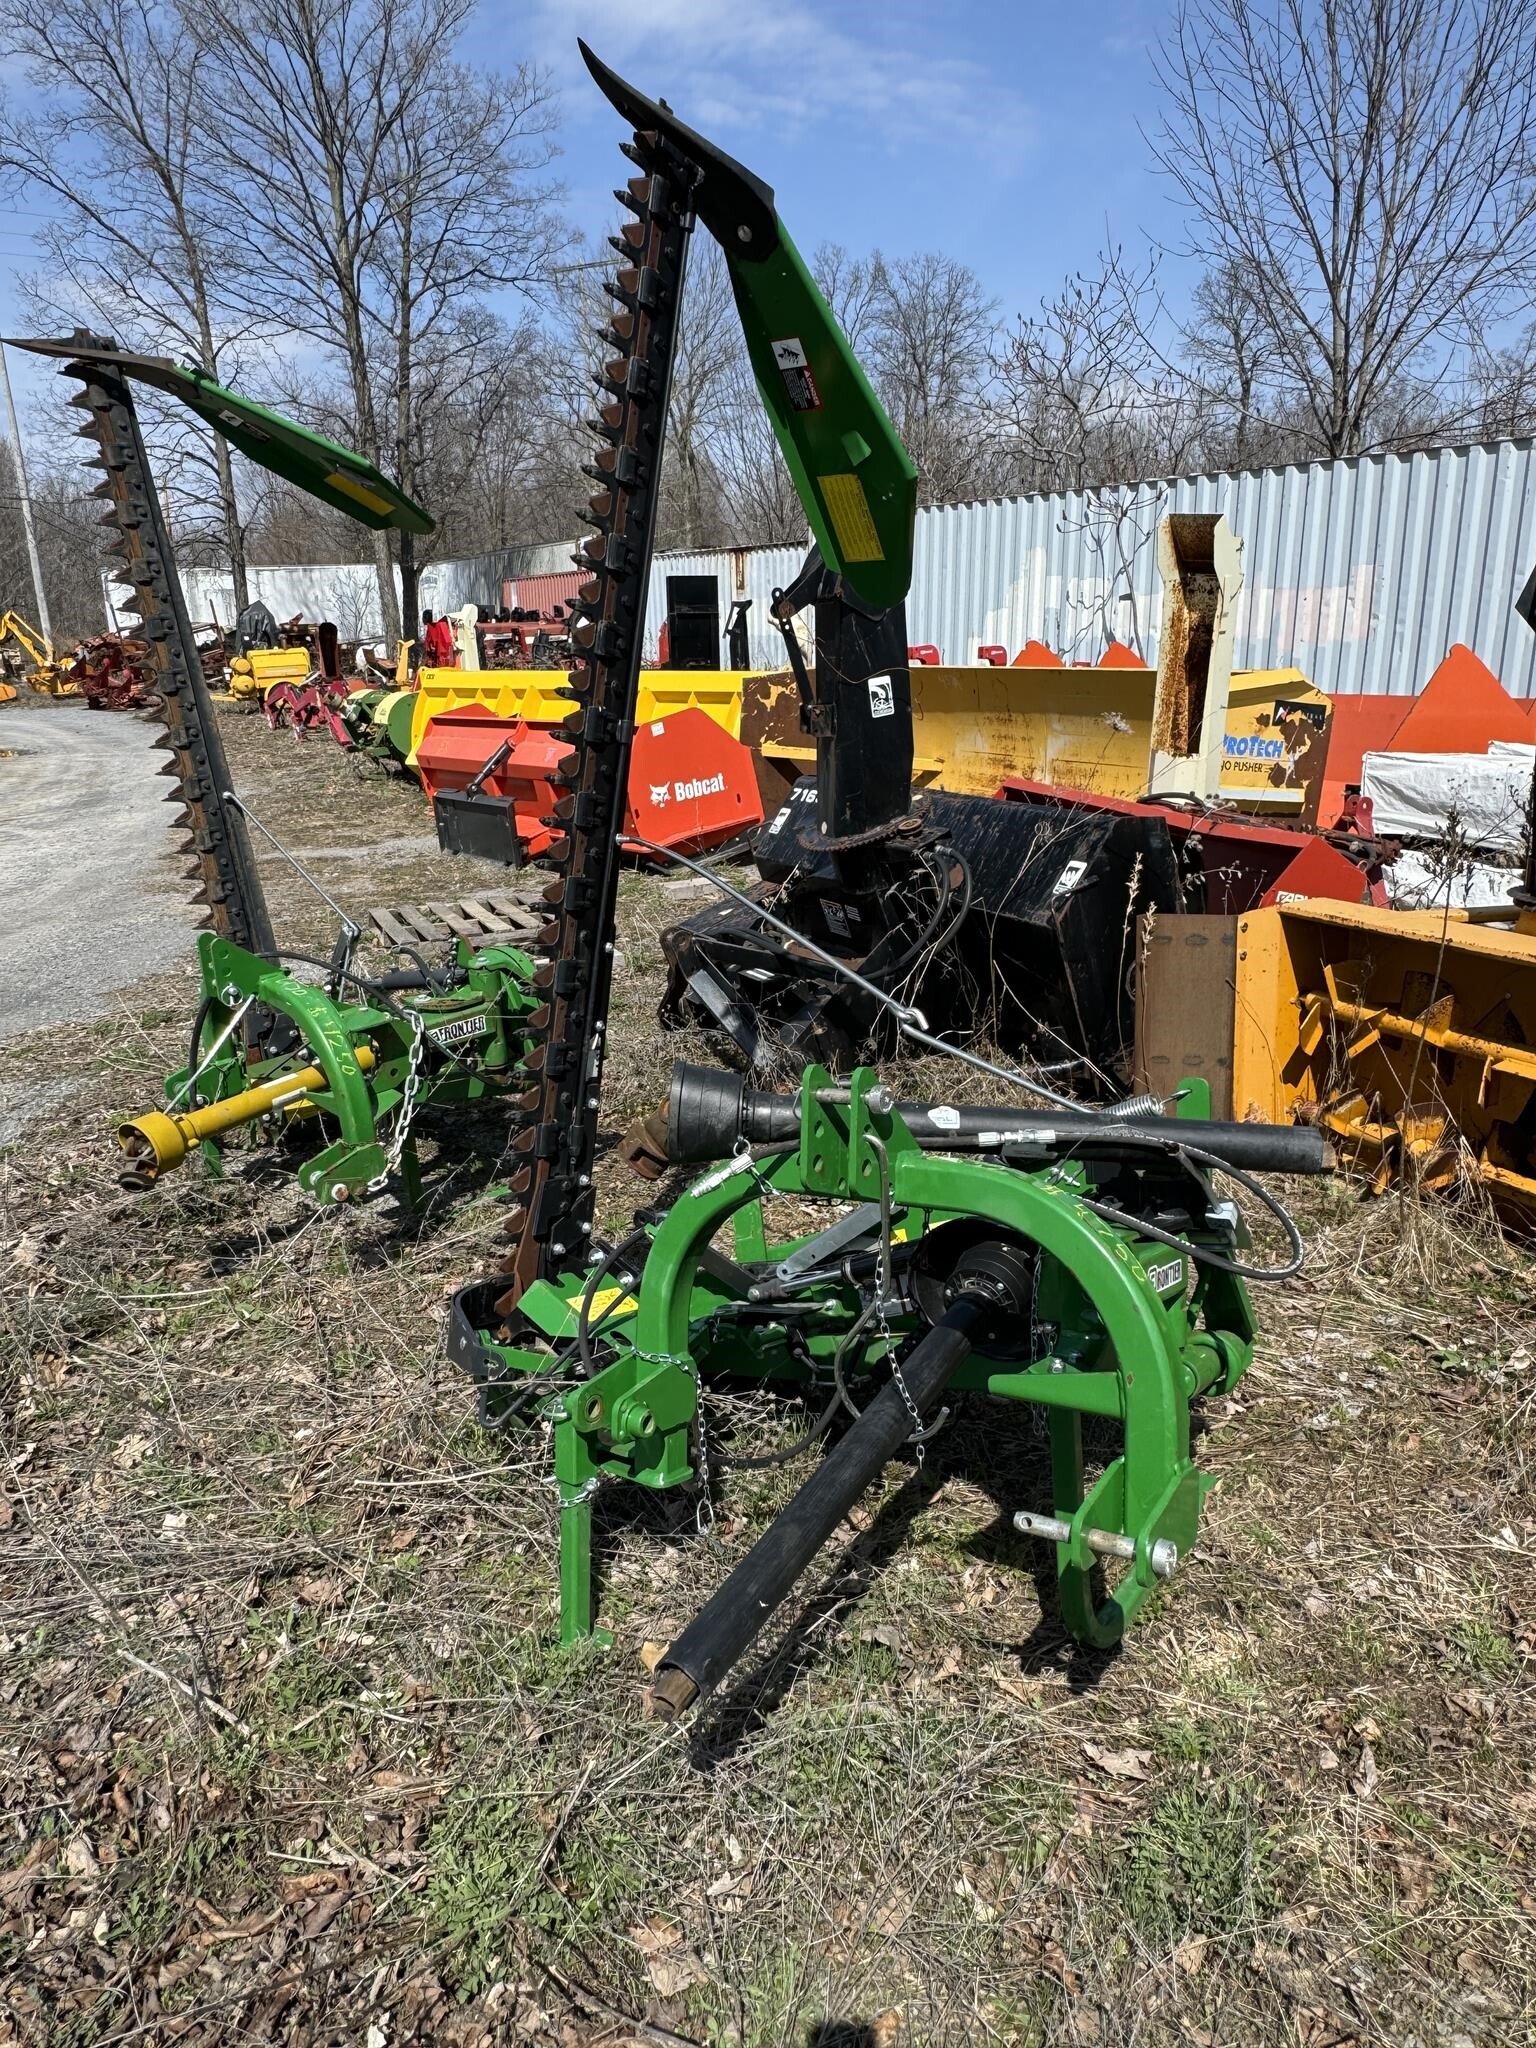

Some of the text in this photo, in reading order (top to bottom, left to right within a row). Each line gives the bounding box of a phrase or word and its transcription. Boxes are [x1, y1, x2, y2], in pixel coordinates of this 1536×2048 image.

[1233, 760, 1263, 772] PUSHER
[674, 772, 725, 801] Bobcat
[790, 787, 818, 803] 716
[438, 1016, 485, 1042] FRONTIER
